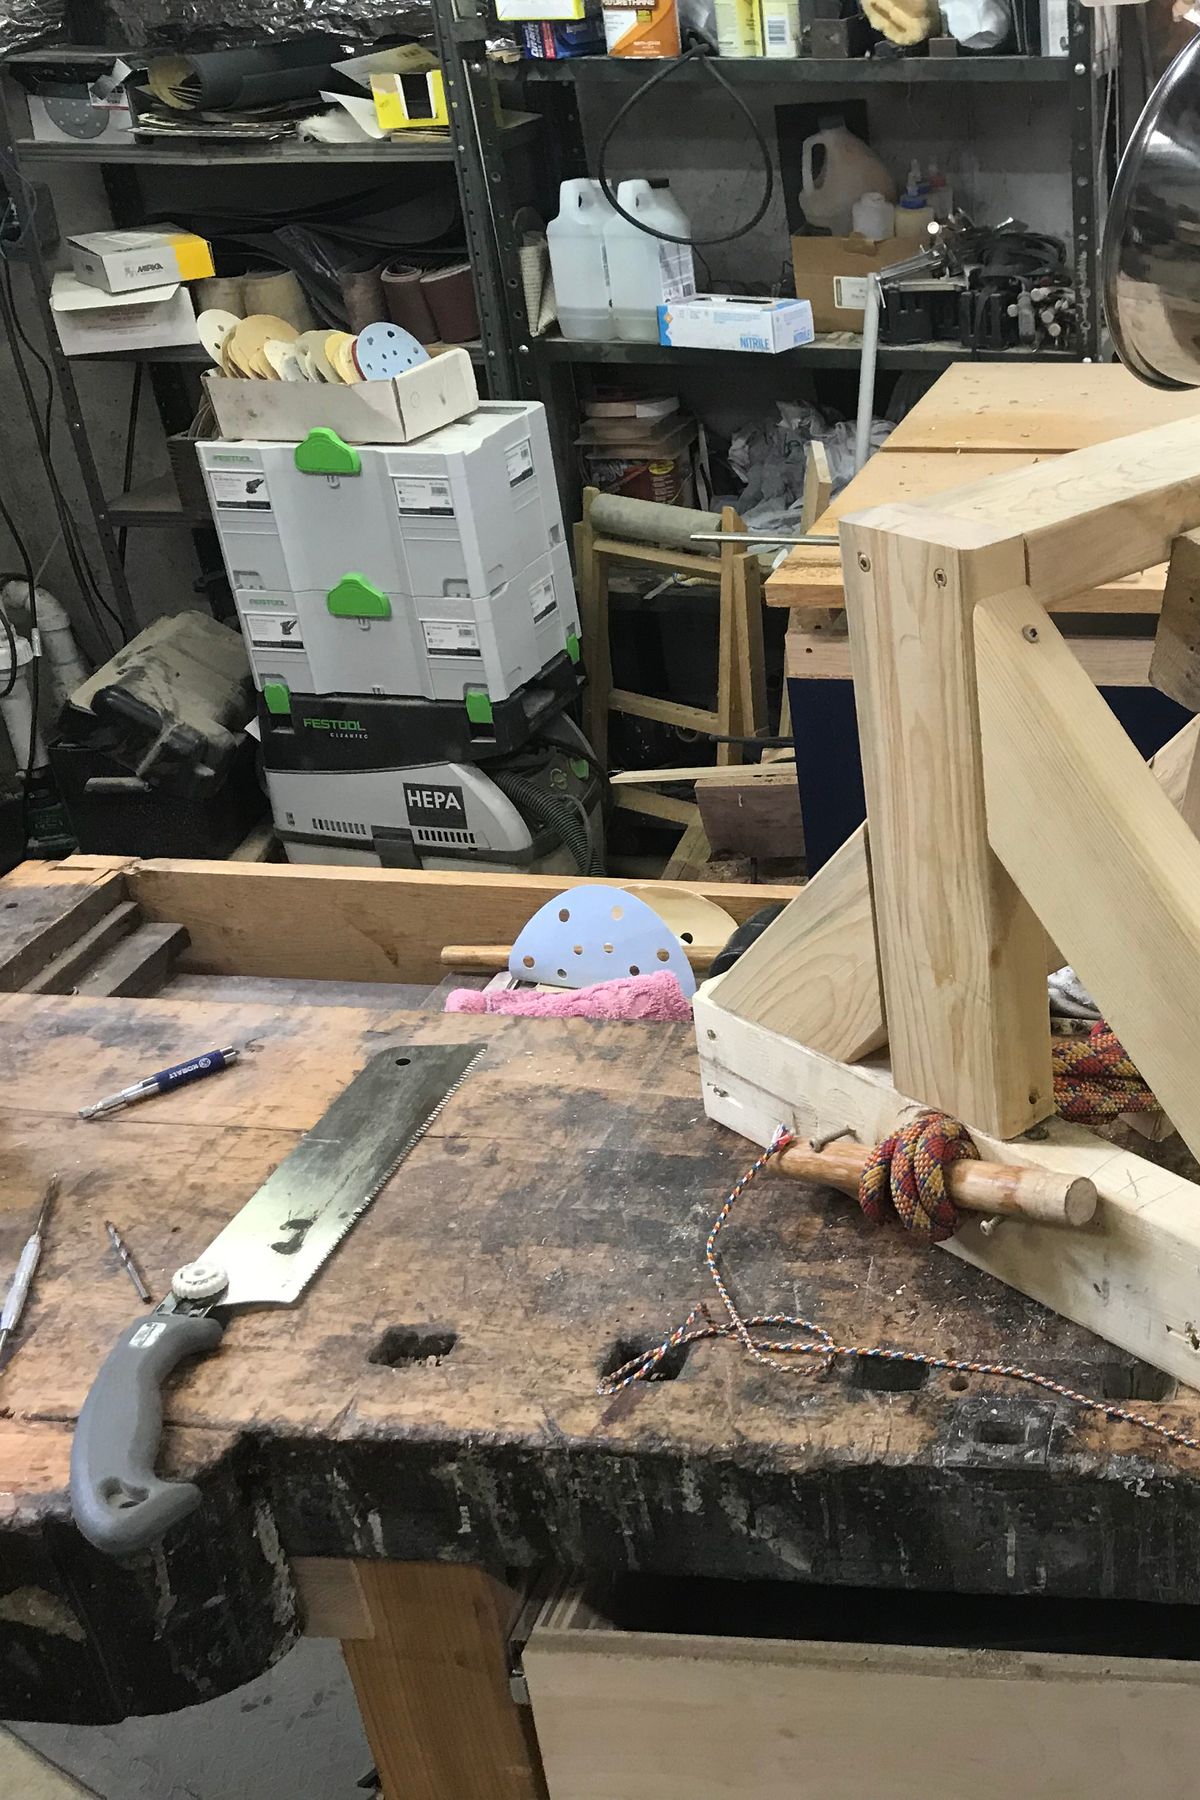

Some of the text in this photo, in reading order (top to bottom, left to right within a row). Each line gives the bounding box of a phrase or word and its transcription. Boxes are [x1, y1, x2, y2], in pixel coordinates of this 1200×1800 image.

[740, 336, 770, 350] NITRILE
[303, 718, 367, 731] FESTOOL
[330, 732, 368, 740] CLEANTEC
[406, 789, 462, 811] HEPA
[168, 1064, 199, 1079] KOBALT
